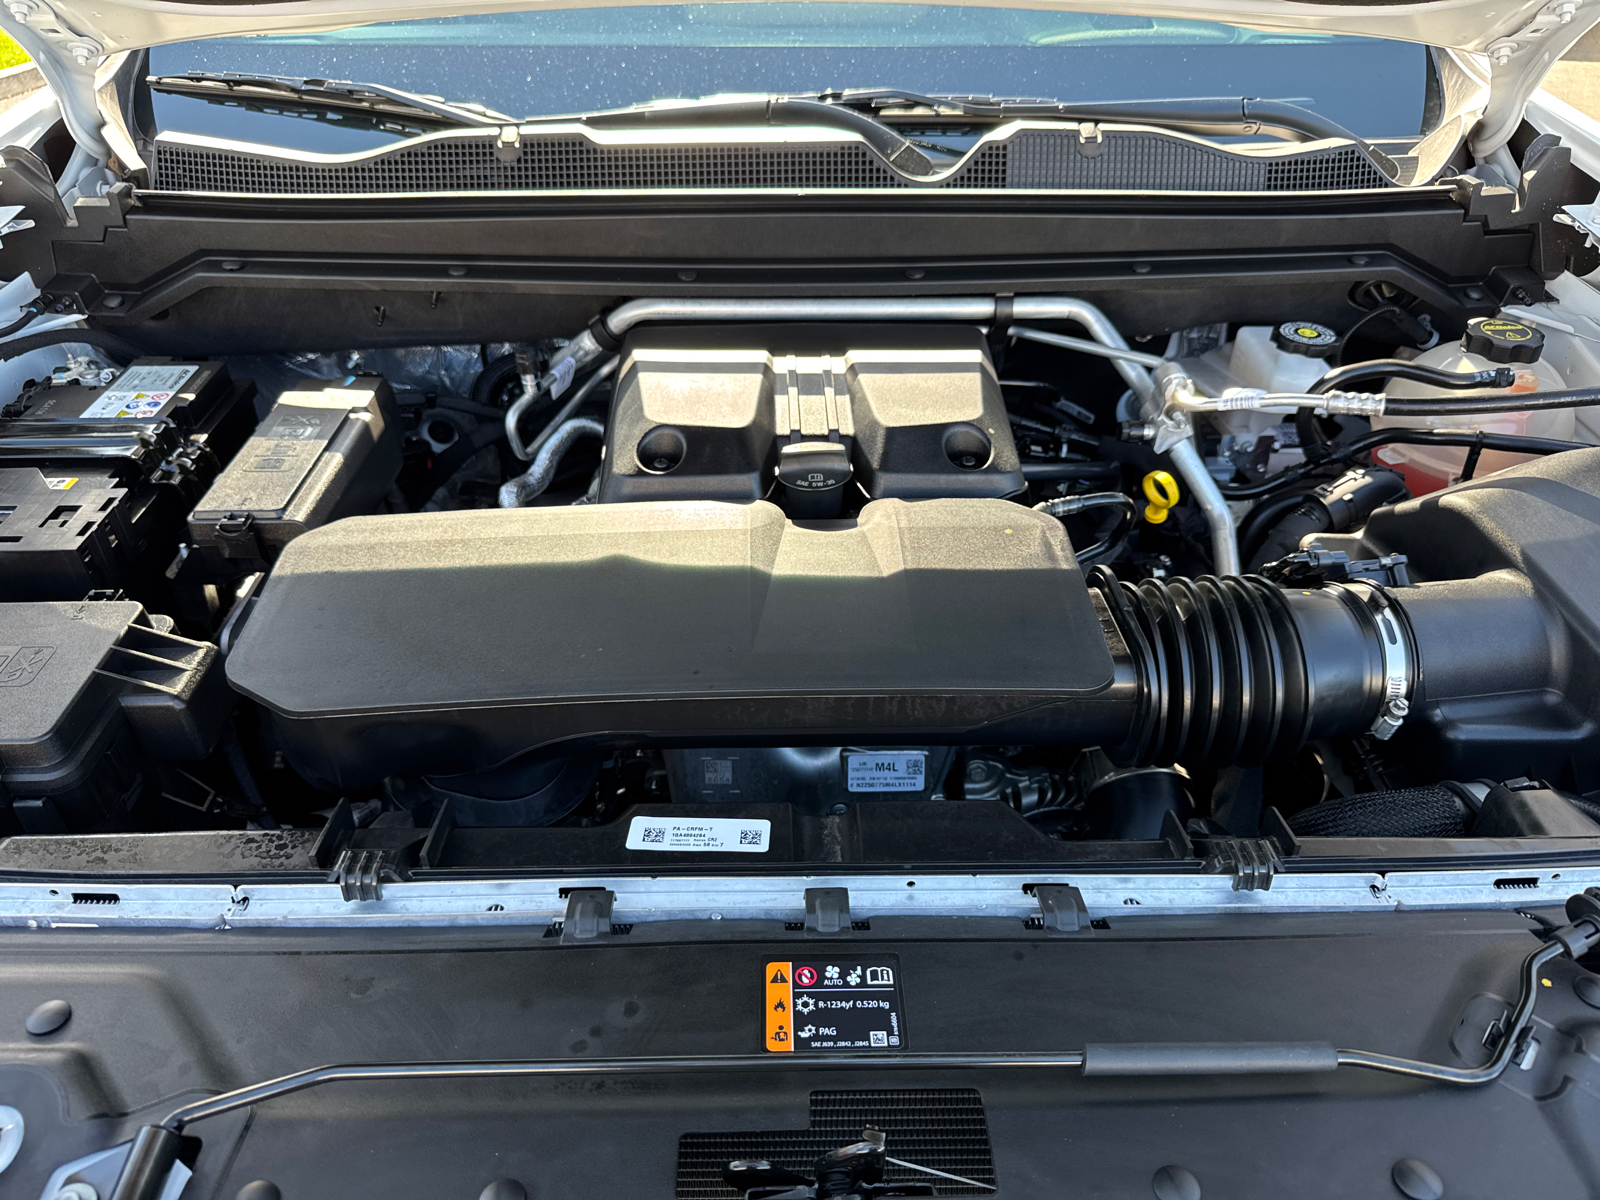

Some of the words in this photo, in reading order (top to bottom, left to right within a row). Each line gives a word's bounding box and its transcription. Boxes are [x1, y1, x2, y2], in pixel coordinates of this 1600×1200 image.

[795, 479, 809, 487] SAE
[875, 762, 898, 772] M4L
[818, 1000, 853, 1010] R-1234yf
[856, 1000, 878, 1008] 0.520
[879, 1000, 890, 1009] kg
[819, 1027, 837, 1036] PAG
